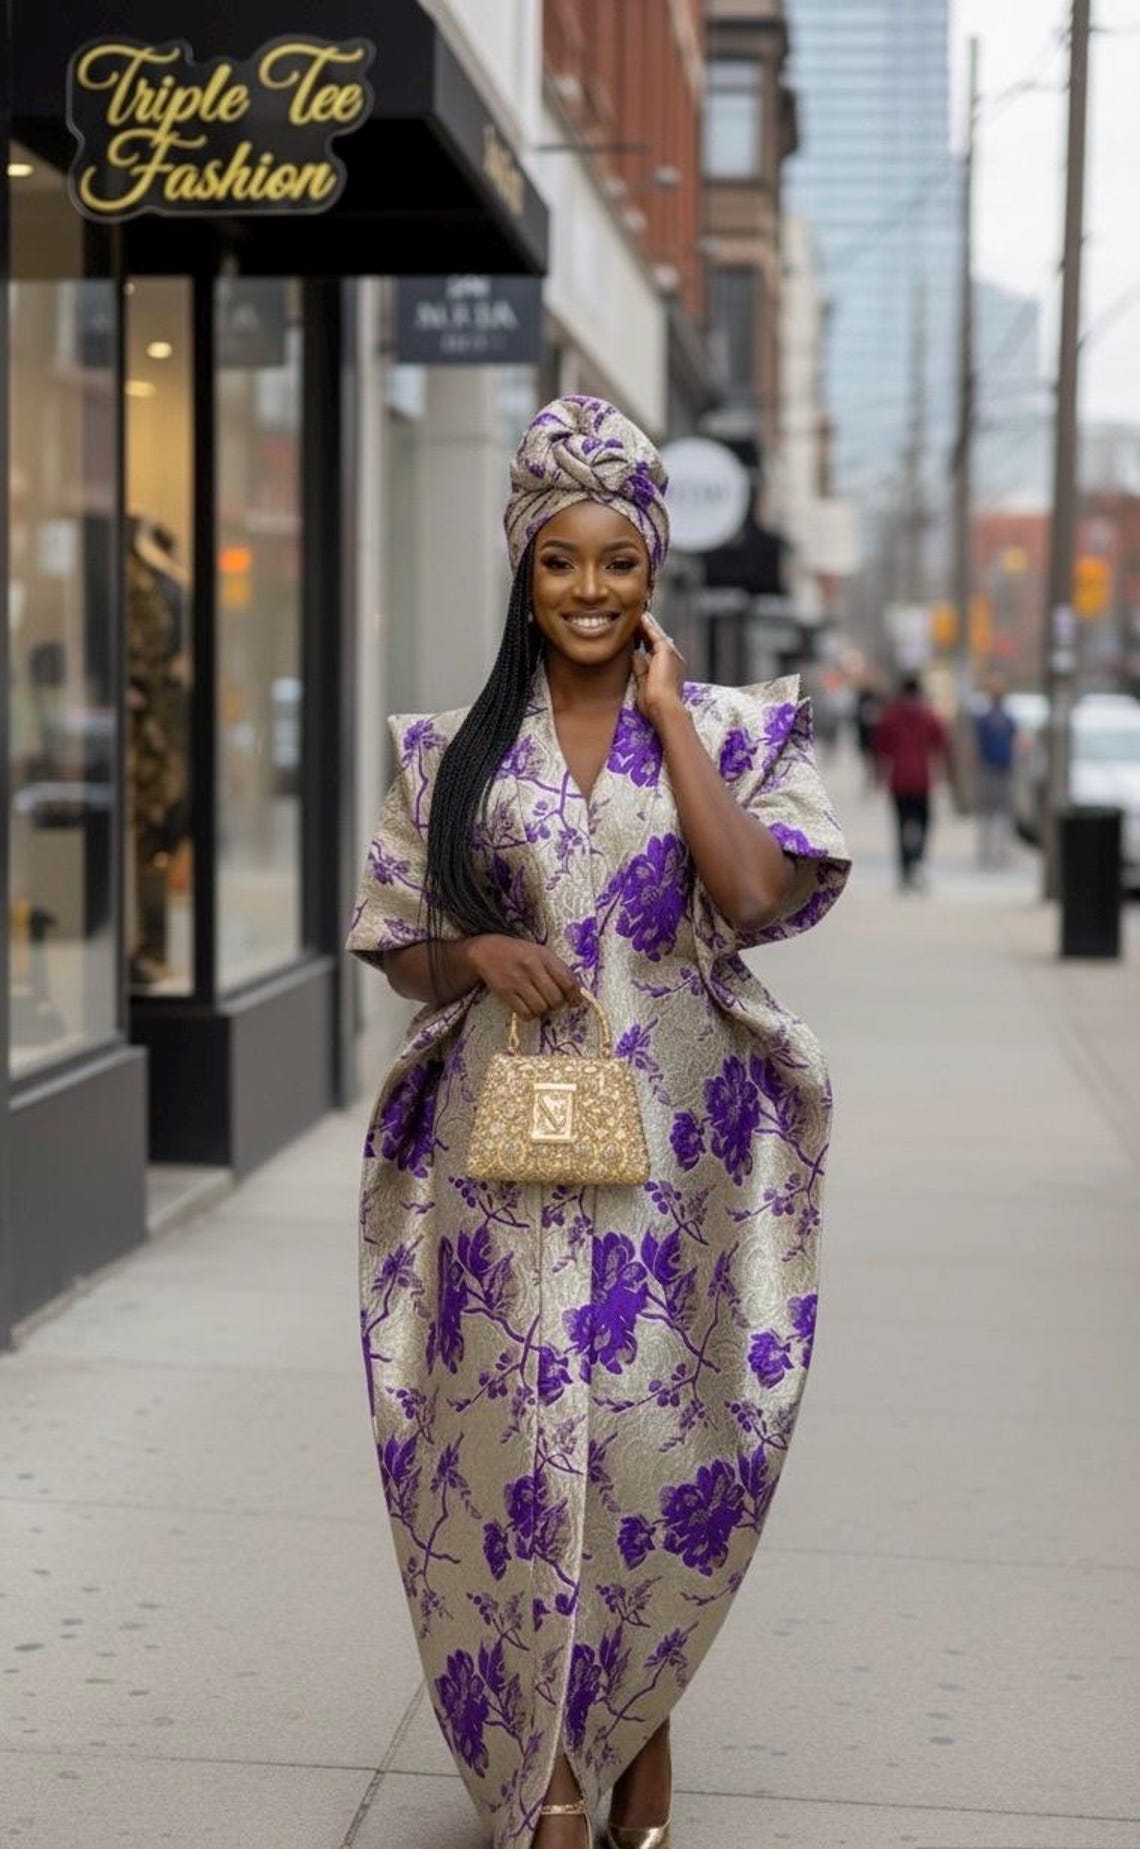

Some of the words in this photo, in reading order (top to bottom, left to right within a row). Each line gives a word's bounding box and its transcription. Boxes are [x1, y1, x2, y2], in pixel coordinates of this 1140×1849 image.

[78, 44, 250, 140] Triple
[258, 43, 363, 125] Tee
[80, 127, 336, 211] Fashion
